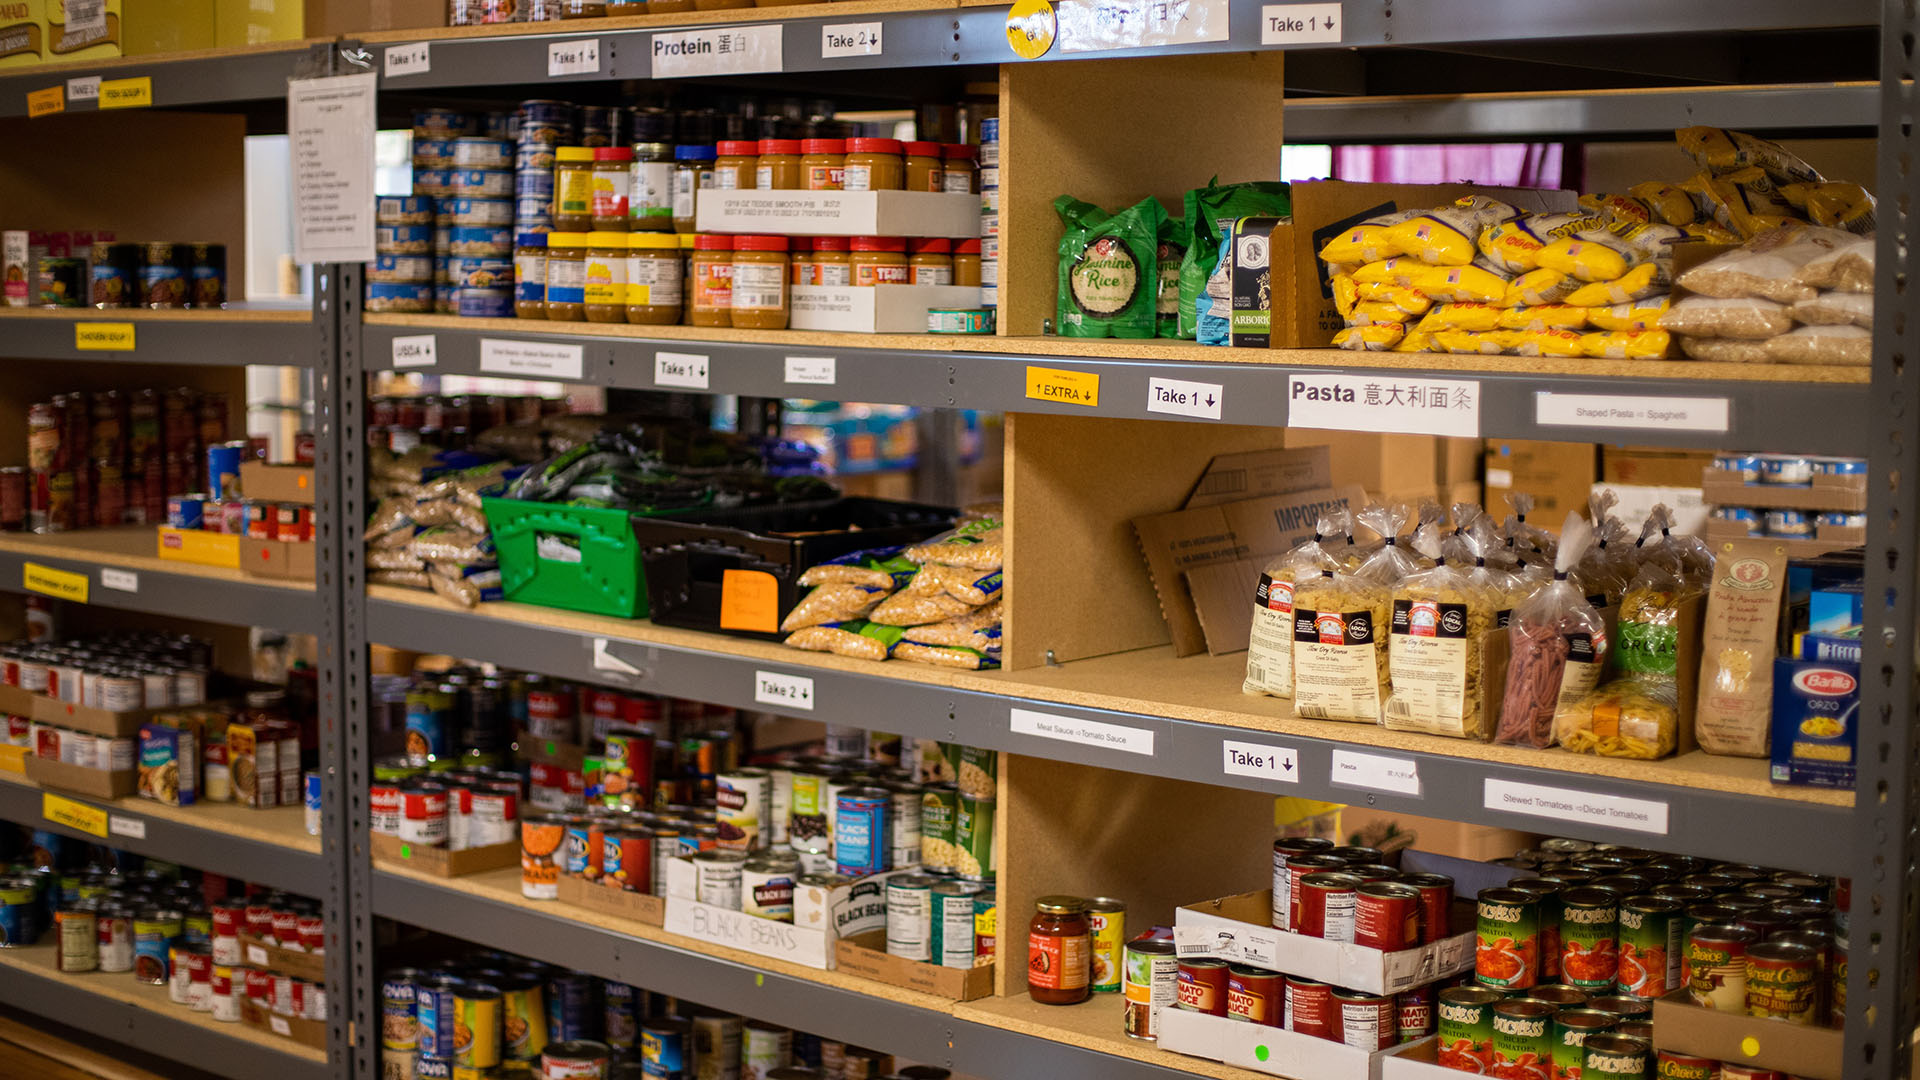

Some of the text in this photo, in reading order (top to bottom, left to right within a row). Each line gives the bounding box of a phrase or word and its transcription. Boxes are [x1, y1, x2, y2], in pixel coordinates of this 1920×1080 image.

[1269, 16, 1316, 32] Take 1
[653, 33, 747, 56] Protein 蛋白
[827, 31, 868, 48] Take 2
[389, 52, 417, 66] Take 1
[553, 51, 585, 64] Take 1
[1087, 270, 1120, 290] Rice
[660, 361, 693, 377] Take 1
[1036, 383, 1080, 401] 1 EXTRA
[1155, 386, 1198, 406] Take 1
[1292, 381, 1472, 410] Pasta 意大利面条
[1576, 406, 1688, 420] Shaped Pasta Spaghetti
[761, 680, 796, 698] Take 2
[1807, 674, 1851, 690] Barilla
[1808, 699, 1840, 711] ORZO
[1037, 722, 1127, 744] Meat Sauce Tomato Sauce
[1229, 750, 1275, 769] Take 1
[1340, 762, 1357, 771] Pasta
[1503, 793, 1649, 822] Stewed Tomatoes Diced Tomatoes
[837, 903, 887, 928] BLACK BEAN
[692, 905, 798, 950] BLACK BEANS
[1178, 983, 1204, 997] MATO
[1178, 994, 1198, 1005] AUCE
[1229, 992, 1254, 1007] MATO
[1228, 1003, 1249, 1015] AUCE
[1400, 1008, 1429, 1018] MATO
[1400, 1018, 1425, 1028] AUCE
[1494, 1015, 1545, 1037] DUCHESS
[1497, 1041, 1537, 1052] TOMATOES
[1503, 1035, 1528, 1043] DICED
[1587, 1053, 1646, 1074] DUCHESS
[1664, 1060, 1705, 1079] Choice
